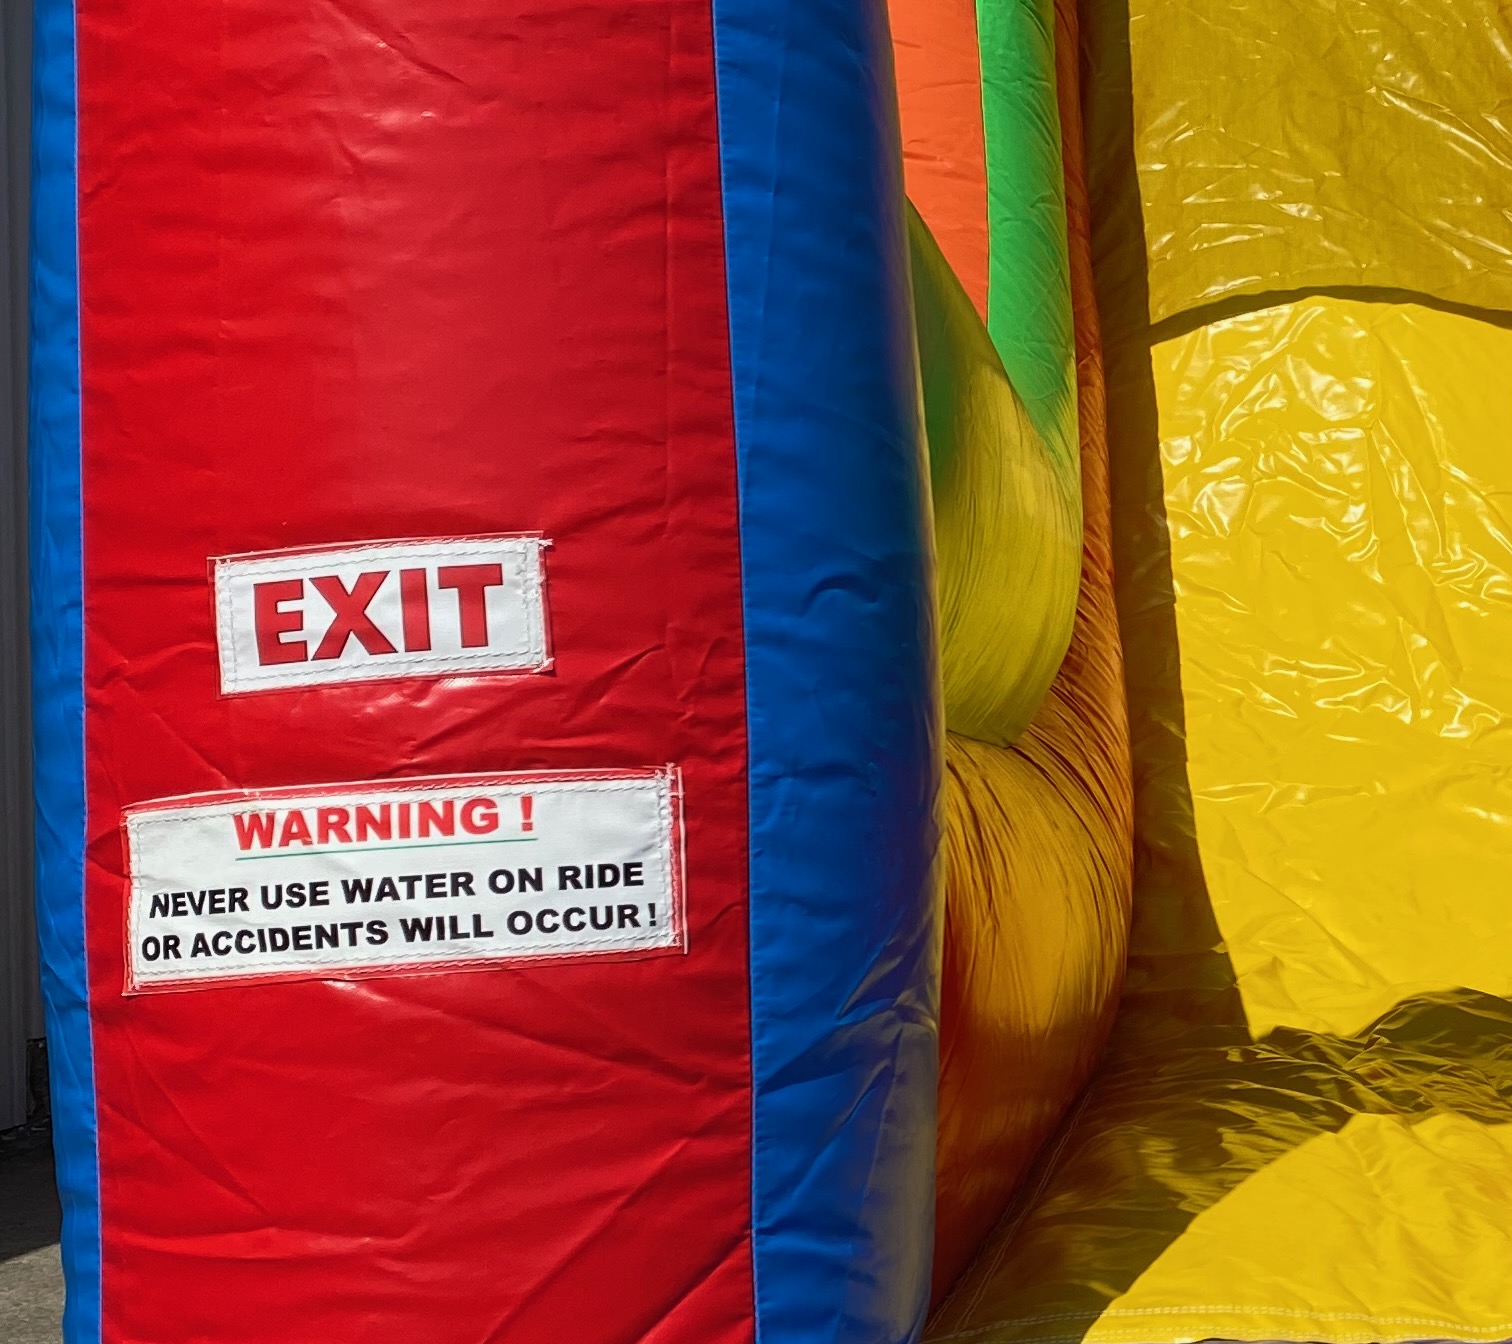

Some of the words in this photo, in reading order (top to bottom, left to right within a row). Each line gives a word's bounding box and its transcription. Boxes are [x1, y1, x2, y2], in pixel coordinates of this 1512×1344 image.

[253, 563, 503, 667] EXIT
[233, 796, 500, 851] WARNING
[149, 887, 249, 919] NEVER
[261, 881, 330, 911] USE
[341, 871, 476, 905] WATER
[488, 866, 544, 895] ON
[558, 862, 644, 891] RIDE
[141, 934, 182, 962] OR
[190, 919, 389, 959] ACCIDENTS
[401, 913, 494, 943] WILL
